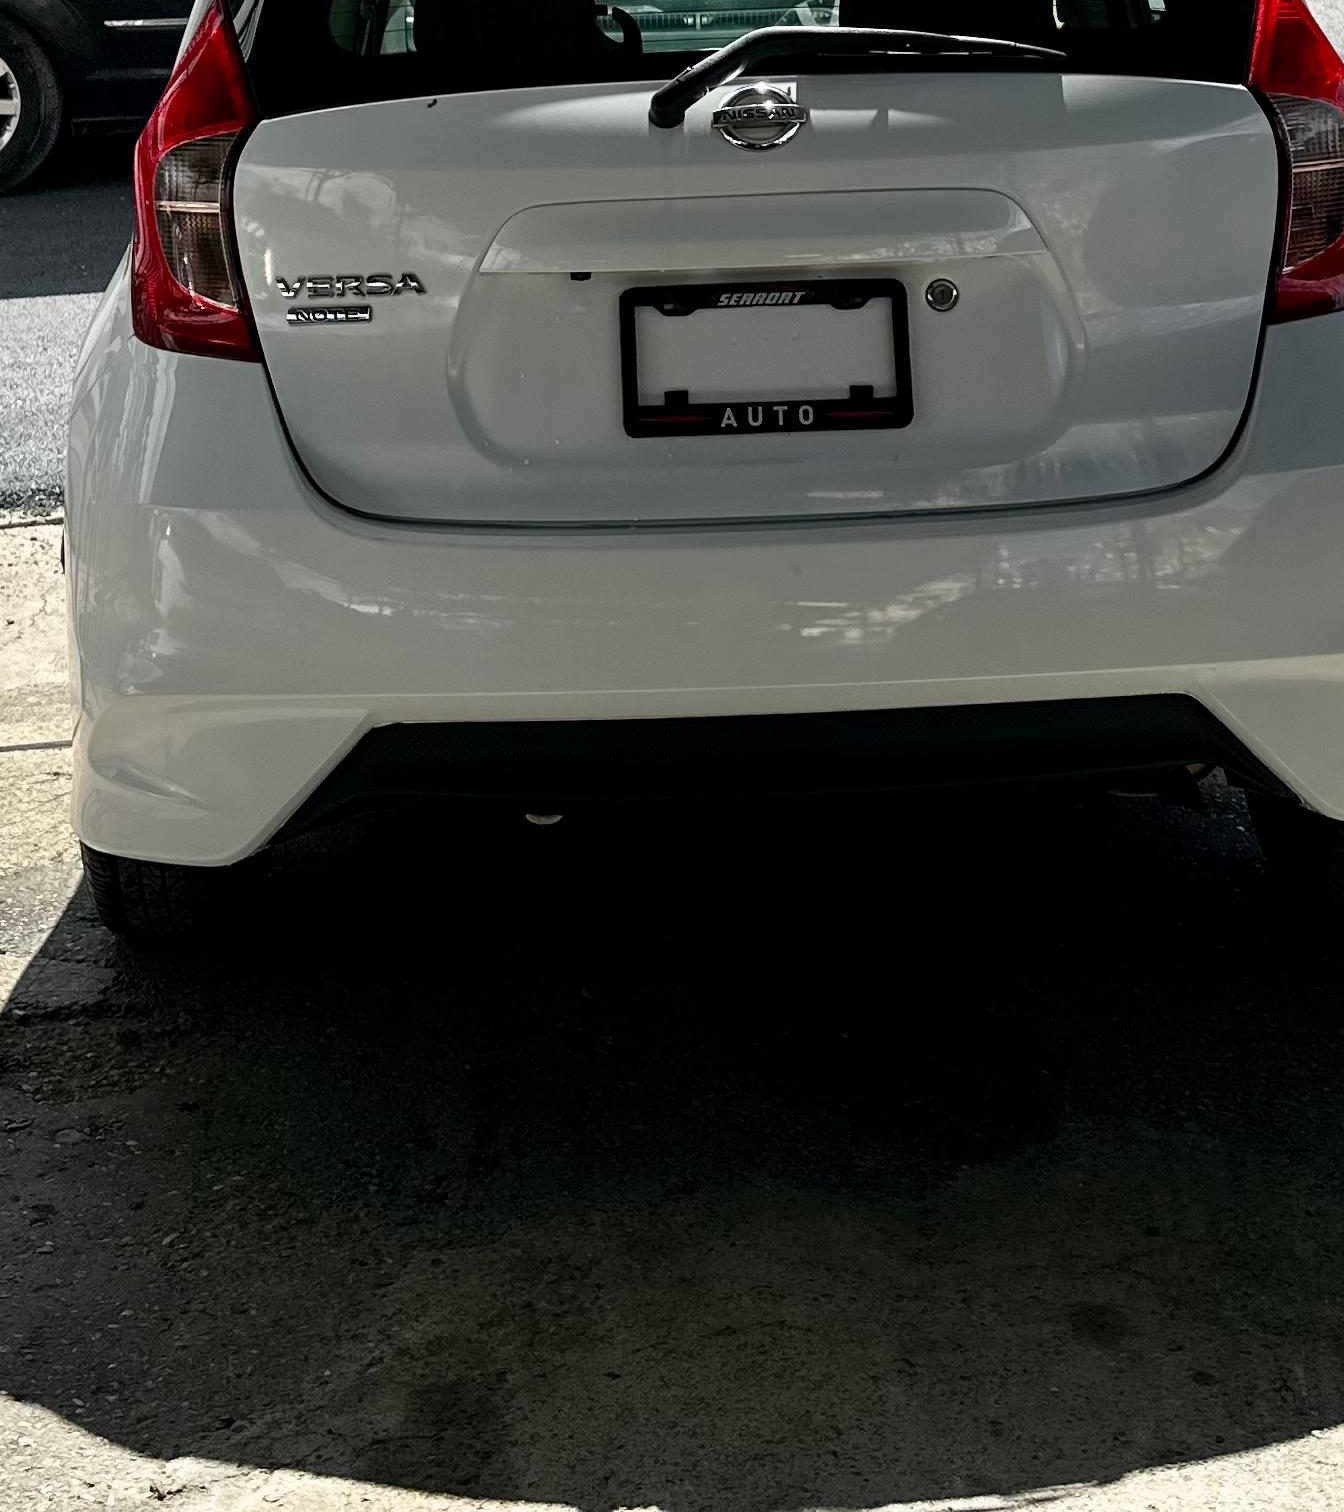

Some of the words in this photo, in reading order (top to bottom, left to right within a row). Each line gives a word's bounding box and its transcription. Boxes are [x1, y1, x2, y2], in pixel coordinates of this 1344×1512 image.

[722, 107, 796, 121] NISSAN
[275, 272, 427, 298] VERSA
[293, 307, 365, 323] NOTE
[720, 404, 815, 427] AUTO
